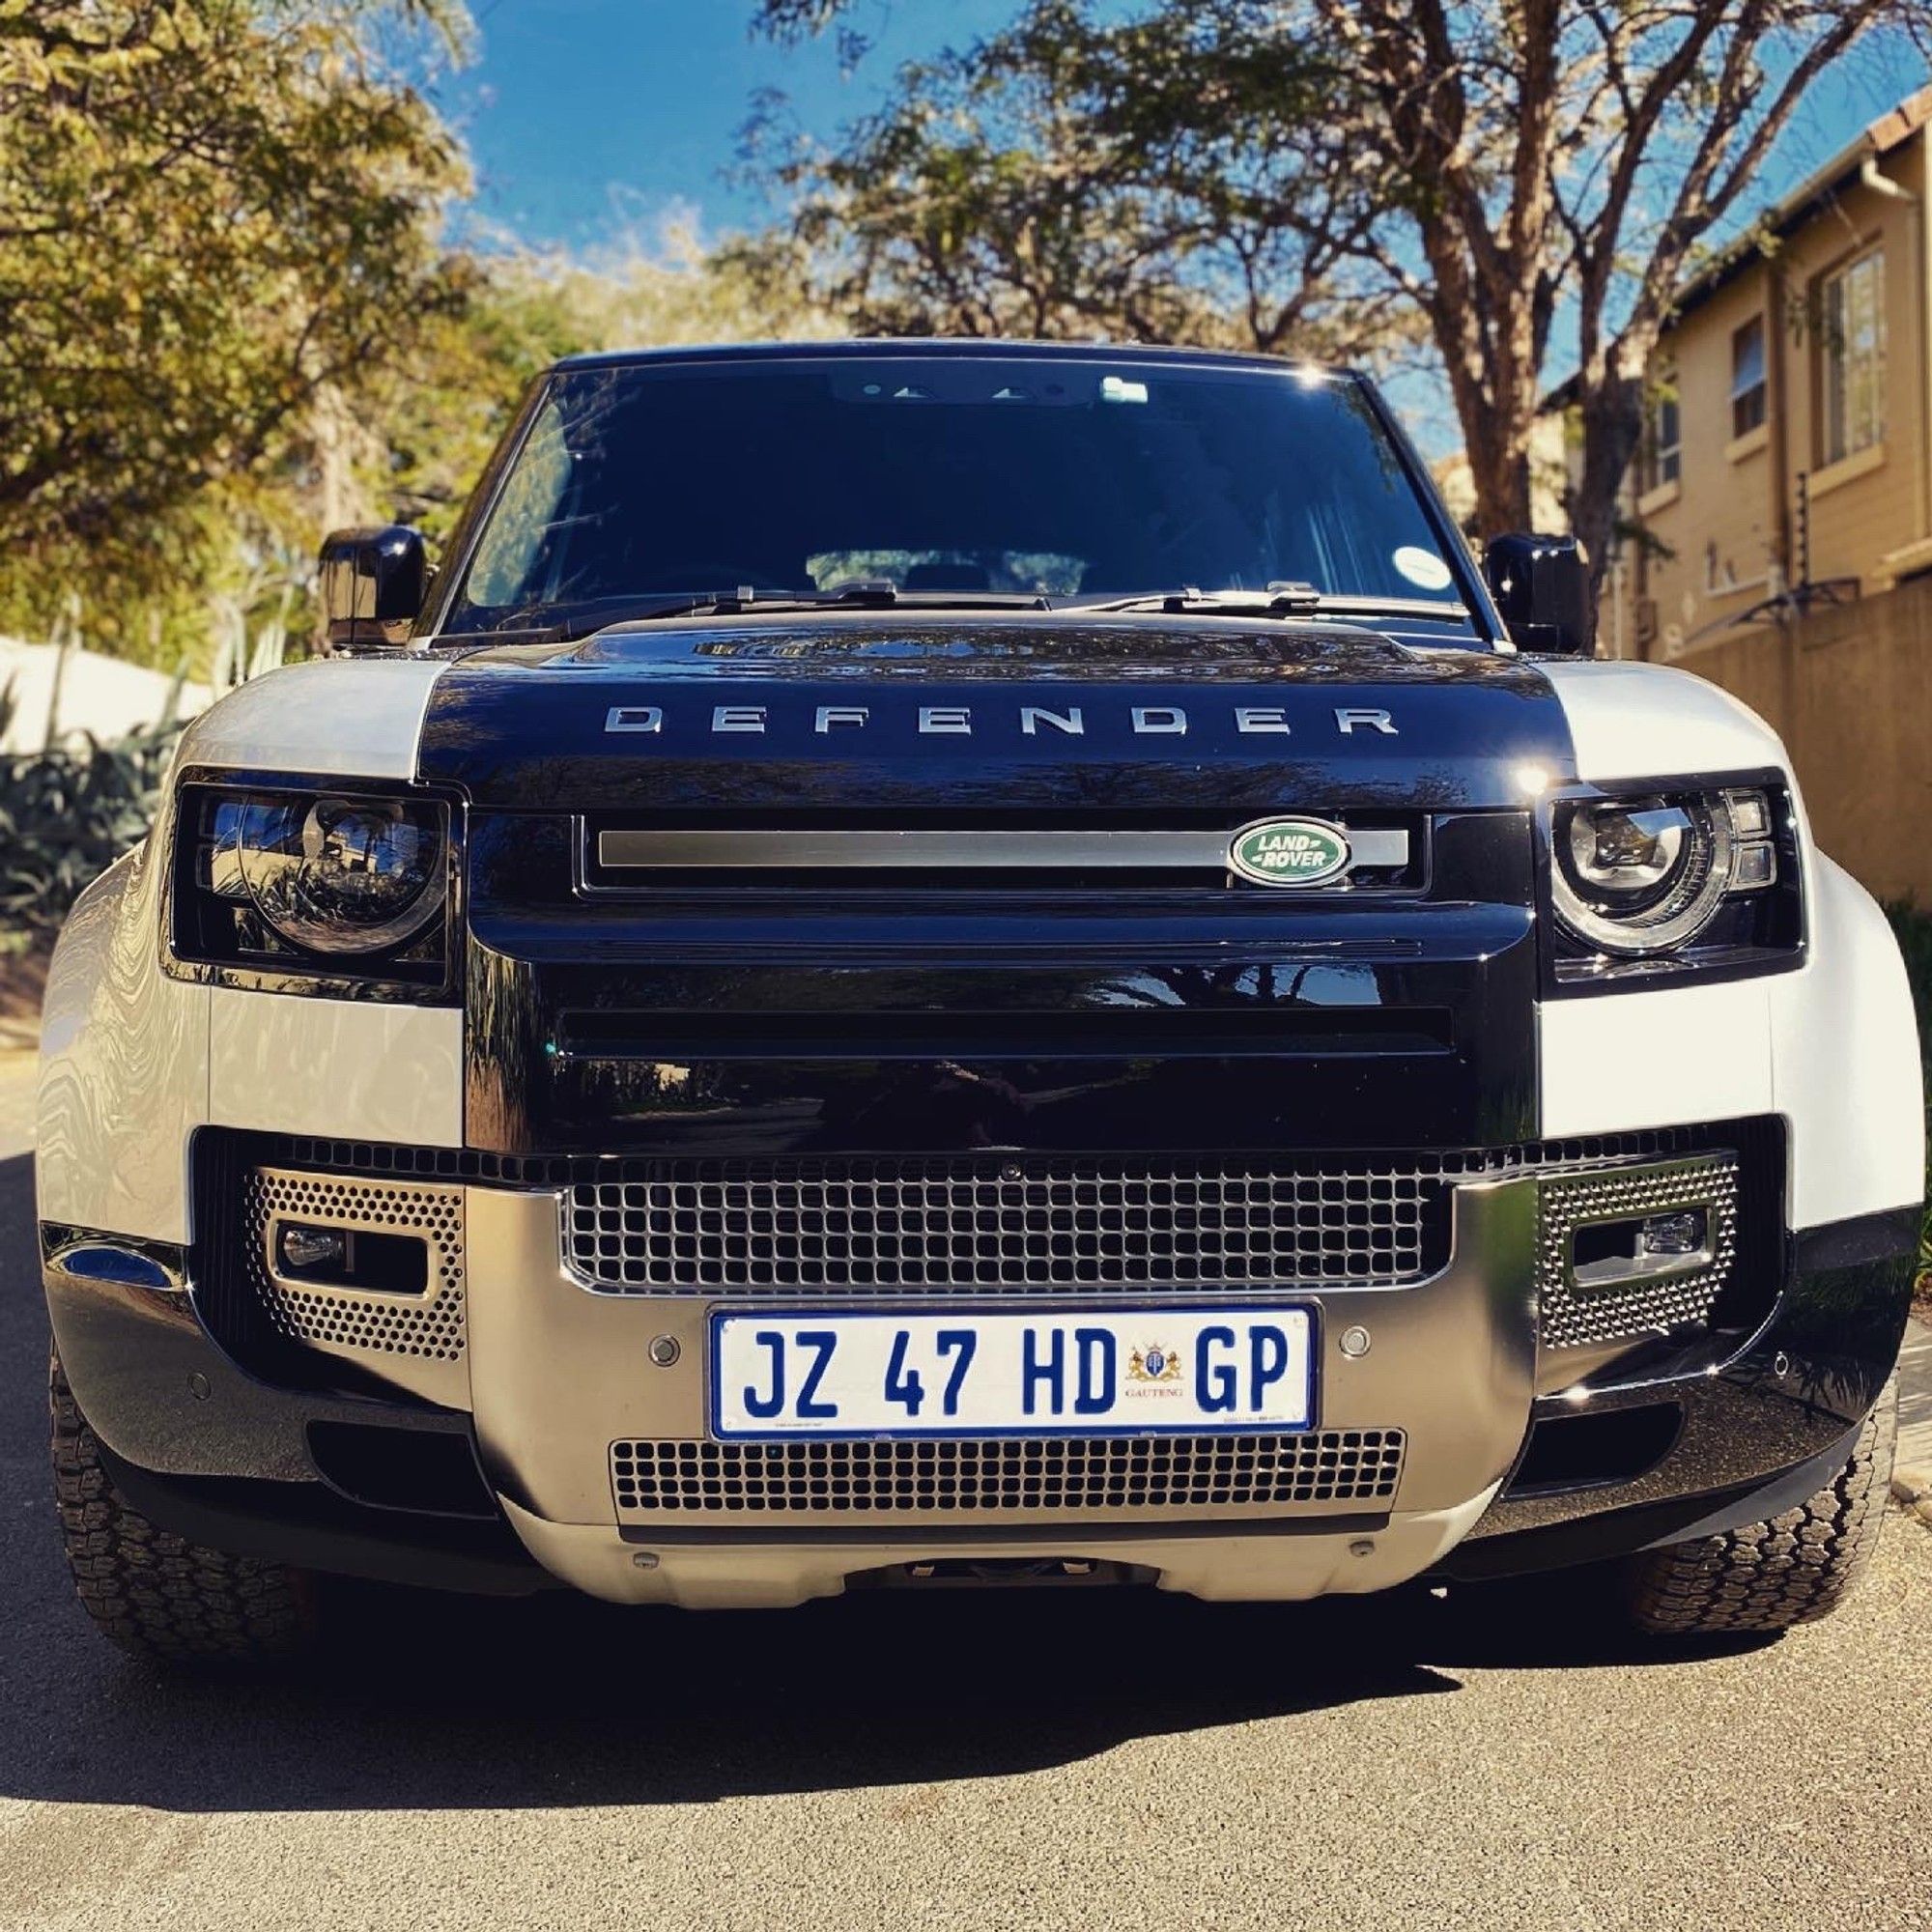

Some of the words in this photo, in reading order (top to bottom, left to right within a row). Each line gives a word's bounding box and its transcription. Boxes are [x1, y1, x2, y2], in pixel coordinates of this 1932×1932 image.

[605, 706, 1399, 735] DEFENDER
[743, 1330, 838, 1418] JZ
[884, 1329, 977, 1417] 47
[1022, 1327, 1116, 1415] HD
[1195, 1325, 1289, 1414] GP
[1124, 1387, 1183, 1398] GAUTENG
